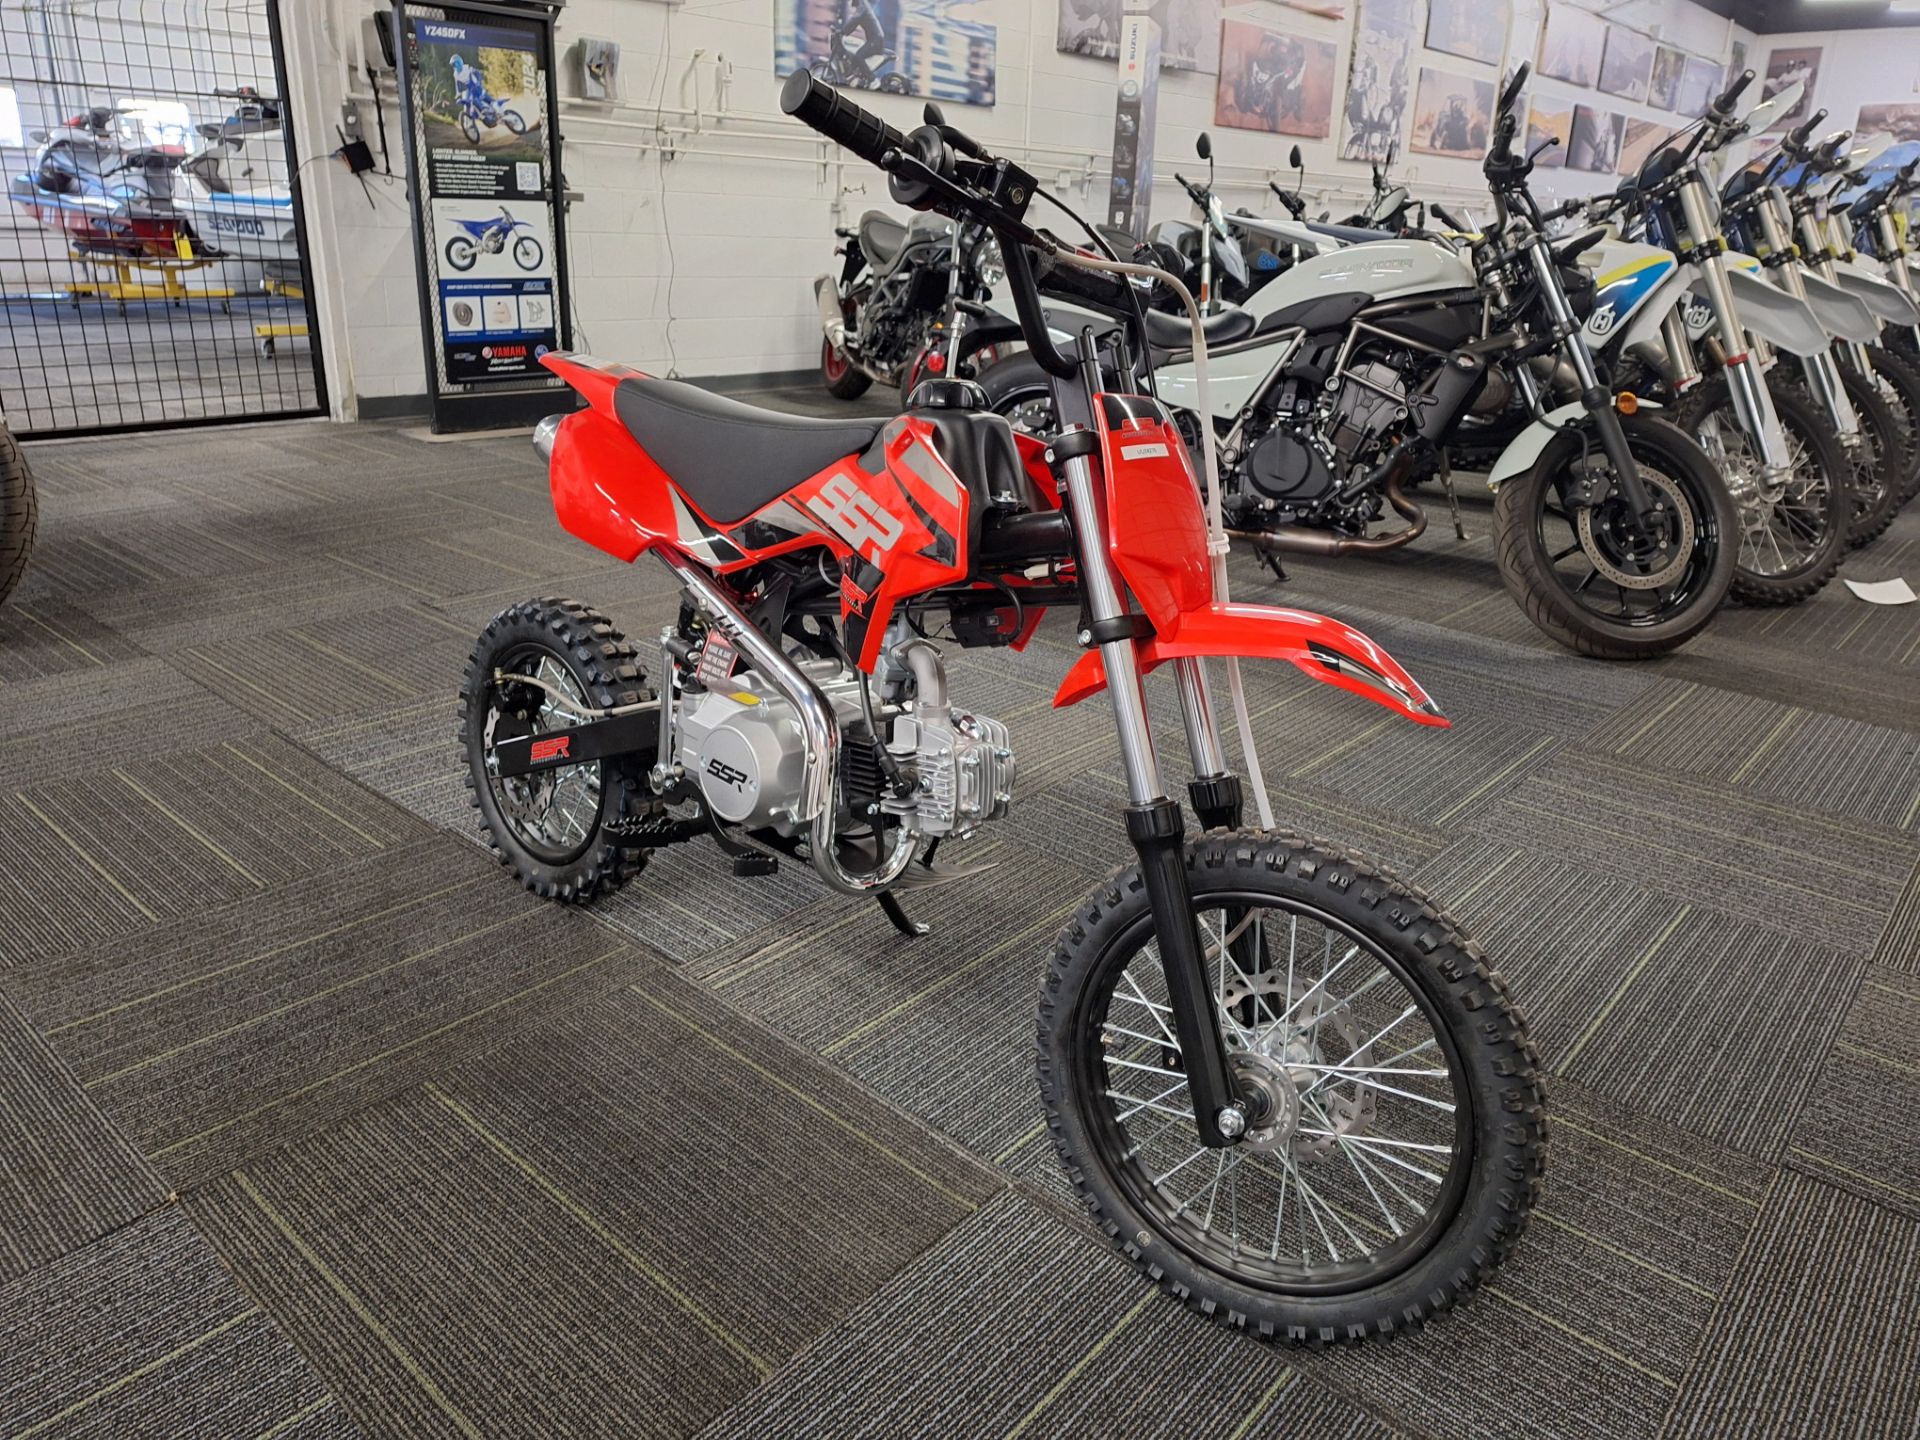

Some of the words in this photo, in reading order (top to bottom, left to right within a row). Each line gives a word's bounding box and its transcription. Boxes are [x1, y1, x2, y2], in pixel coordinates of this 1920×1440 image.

[424, 24, 466, 40] YZ450FX
[1129, 23, 1138, 60] SUZUKI
[492, 345, 527, 358] YAMAHA
[805, 472, 905, 570] SSR
[531, 736, 570, 761] SSR
[707, 758, 748, 793] SSR
